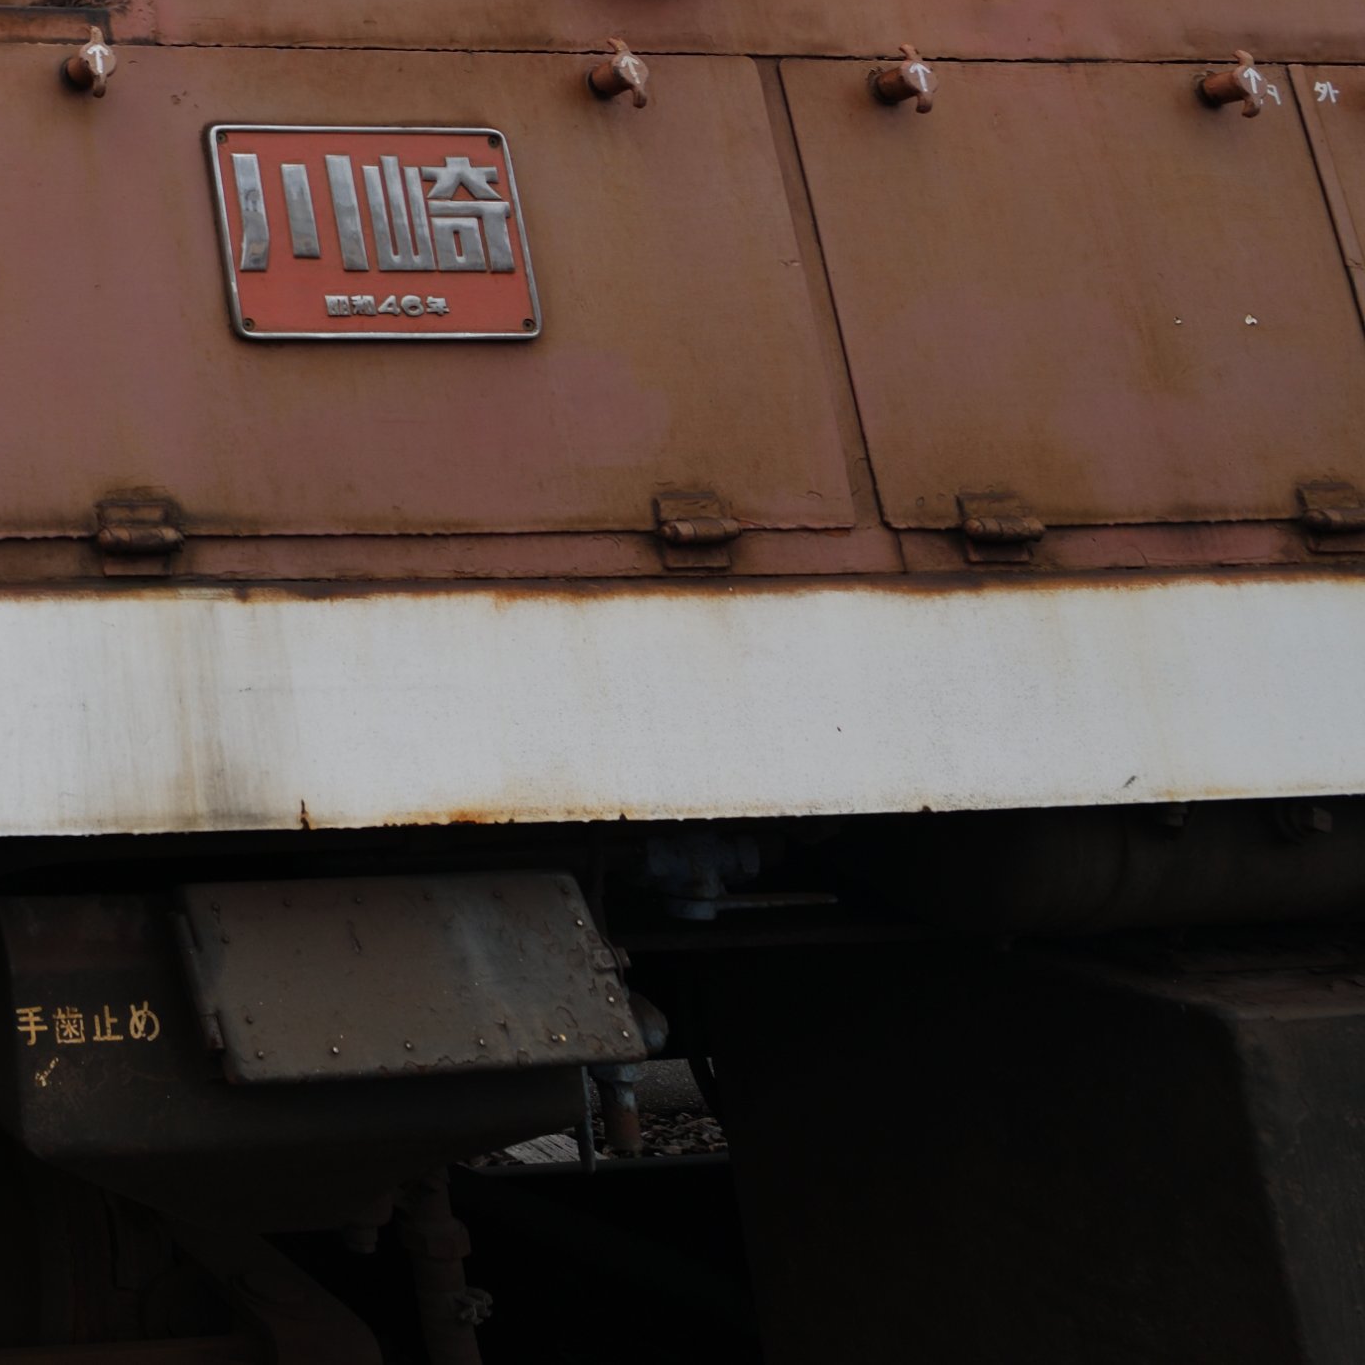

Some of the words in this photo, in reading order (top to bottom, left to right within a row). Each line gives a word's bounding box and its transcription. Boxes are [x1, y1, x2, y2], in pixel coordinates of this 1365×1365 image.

[231, 152, 516, 274] 川崎
[14, 1000, 162, 1047] 手歯止め
